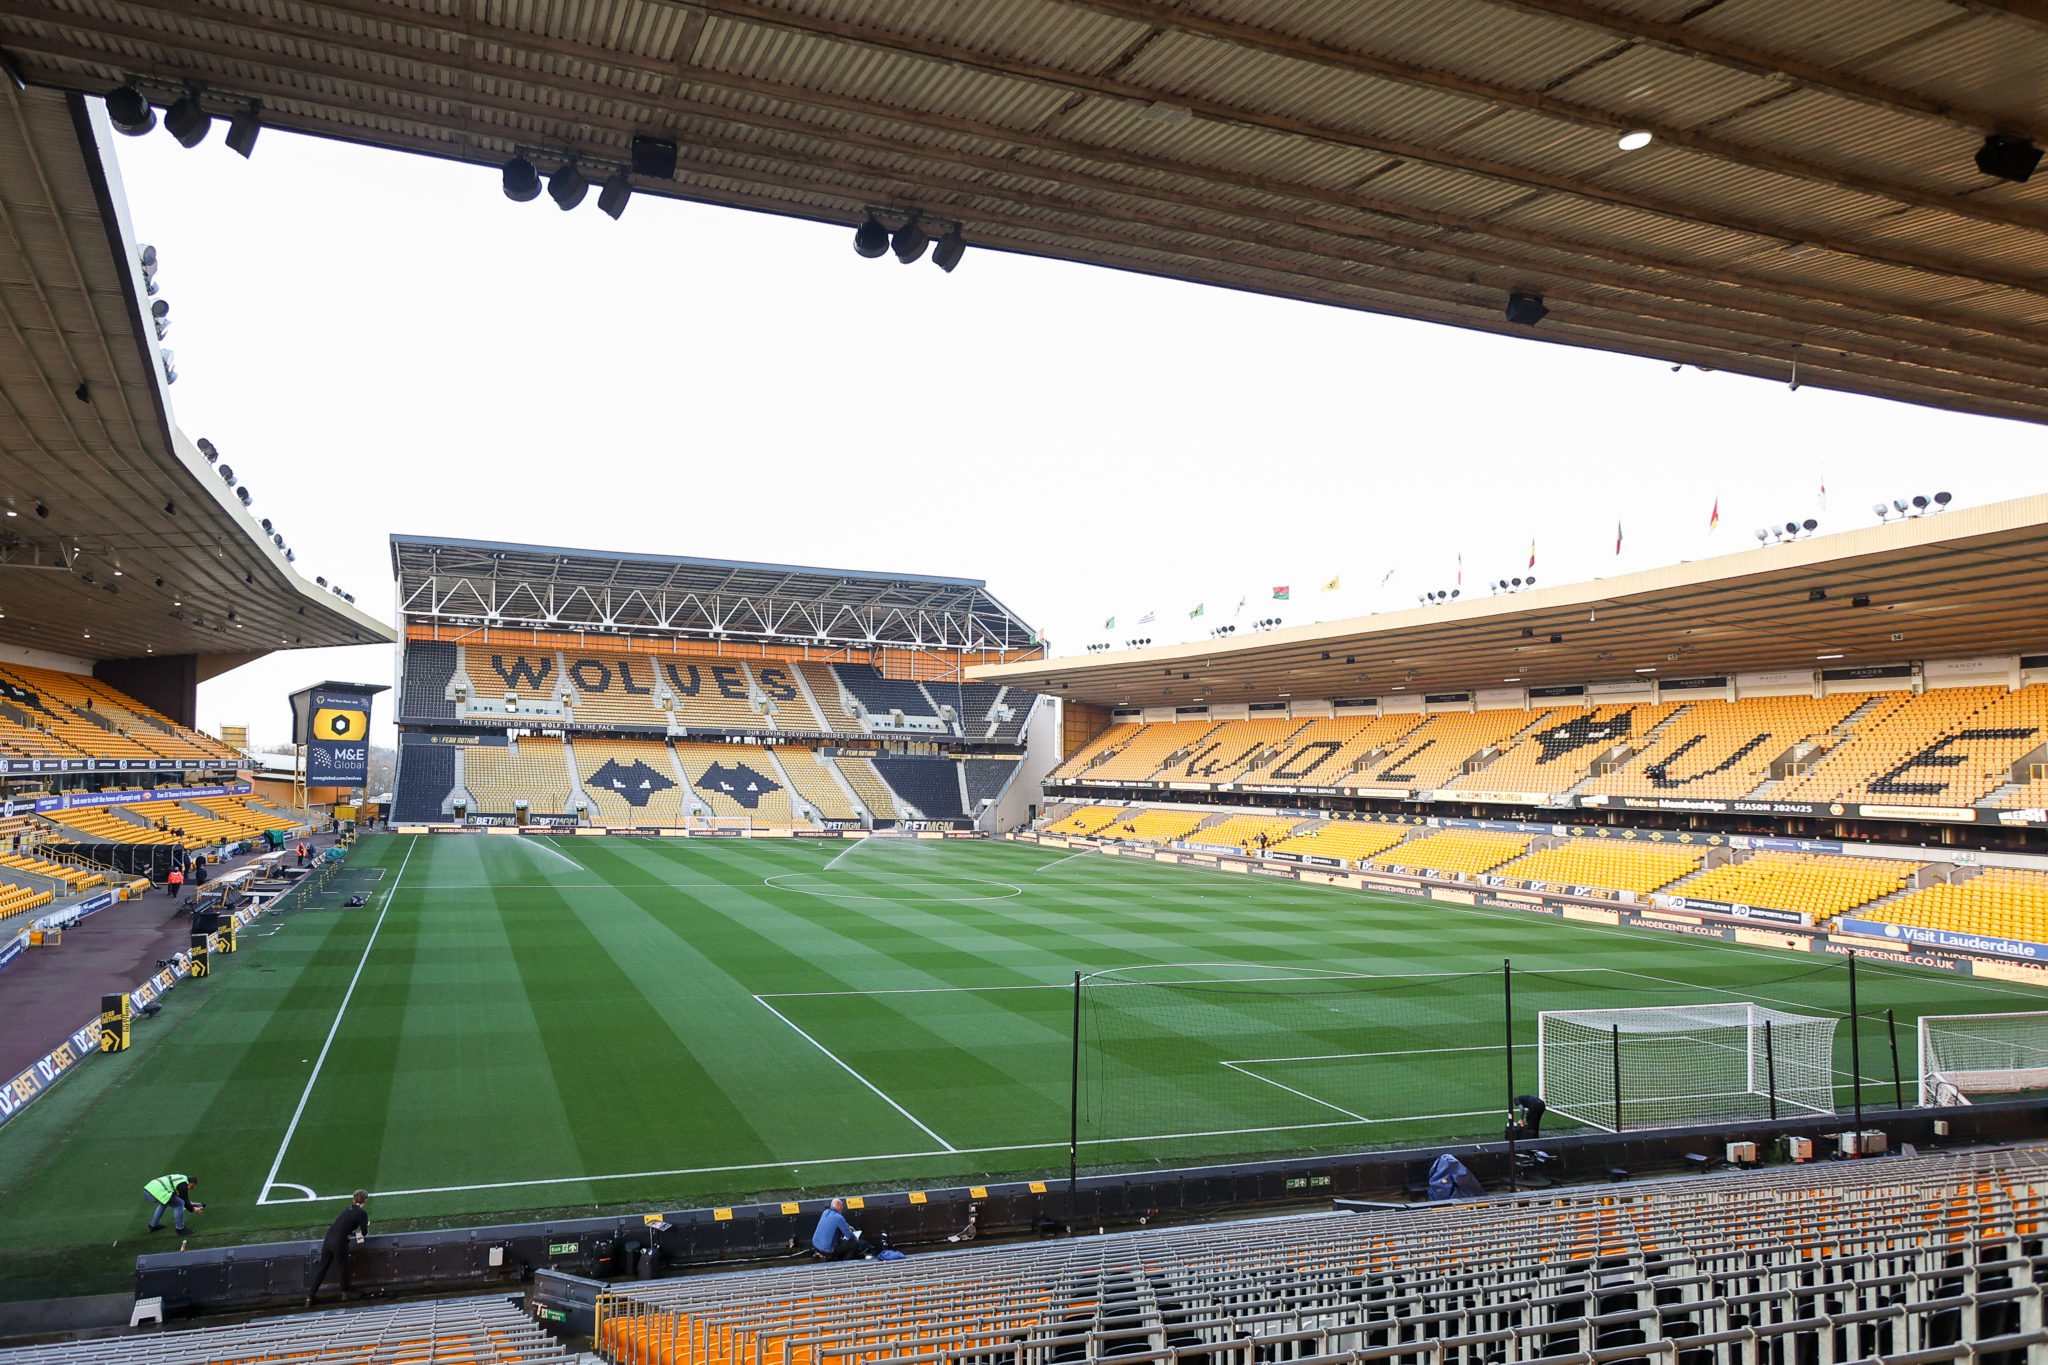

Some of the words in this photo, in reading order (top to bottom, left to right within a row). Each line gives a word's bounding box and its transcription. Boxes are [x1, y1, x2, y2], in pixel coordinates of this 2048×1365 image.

[1850, 668, 1883, 676] MANDER
[1948, 661, 1983, 669] MANDER
[492, 655, 796, 700] WOLVES
[442, 736, 457, 744] FEAR
[334, 748, 365, 760] M&E
[334, 760, 365, 769] Global
[1455, 792, 1481, 800] WELCOME
[1624, 797, 1659, 808] Wolves
[1659, 798, 1727, 813] Memberships
[1734, 802, 1771, 812] SEASON
[1773, 803, 1813, 813] 2024/25
[476, 816, 516, 825] BETMGM
[1367, 883, 1425, 897] MANDERCENTRE.CO.UK
[1482, 898, 1555, 915] MANDERCENTRE.CO.UK
[1671, 898, 1684, 907] JD
[1735, 906, 1748, 915] JD
[1750, 909, 1799, 921] JDSPORTS.COM
[1629, 918, 1725, 938] MANDERCENTRE.CO.UK
[1902, 926, 1936, 943] Visit
[1939, 932, 2036, 958] Lauderdale
[1825, 944, 1956, 970] MANDERCENTRE.CO.UK
[102, 1010, 115, 1019] FEAR
[72, 1018, 102, 1053] DEBE
